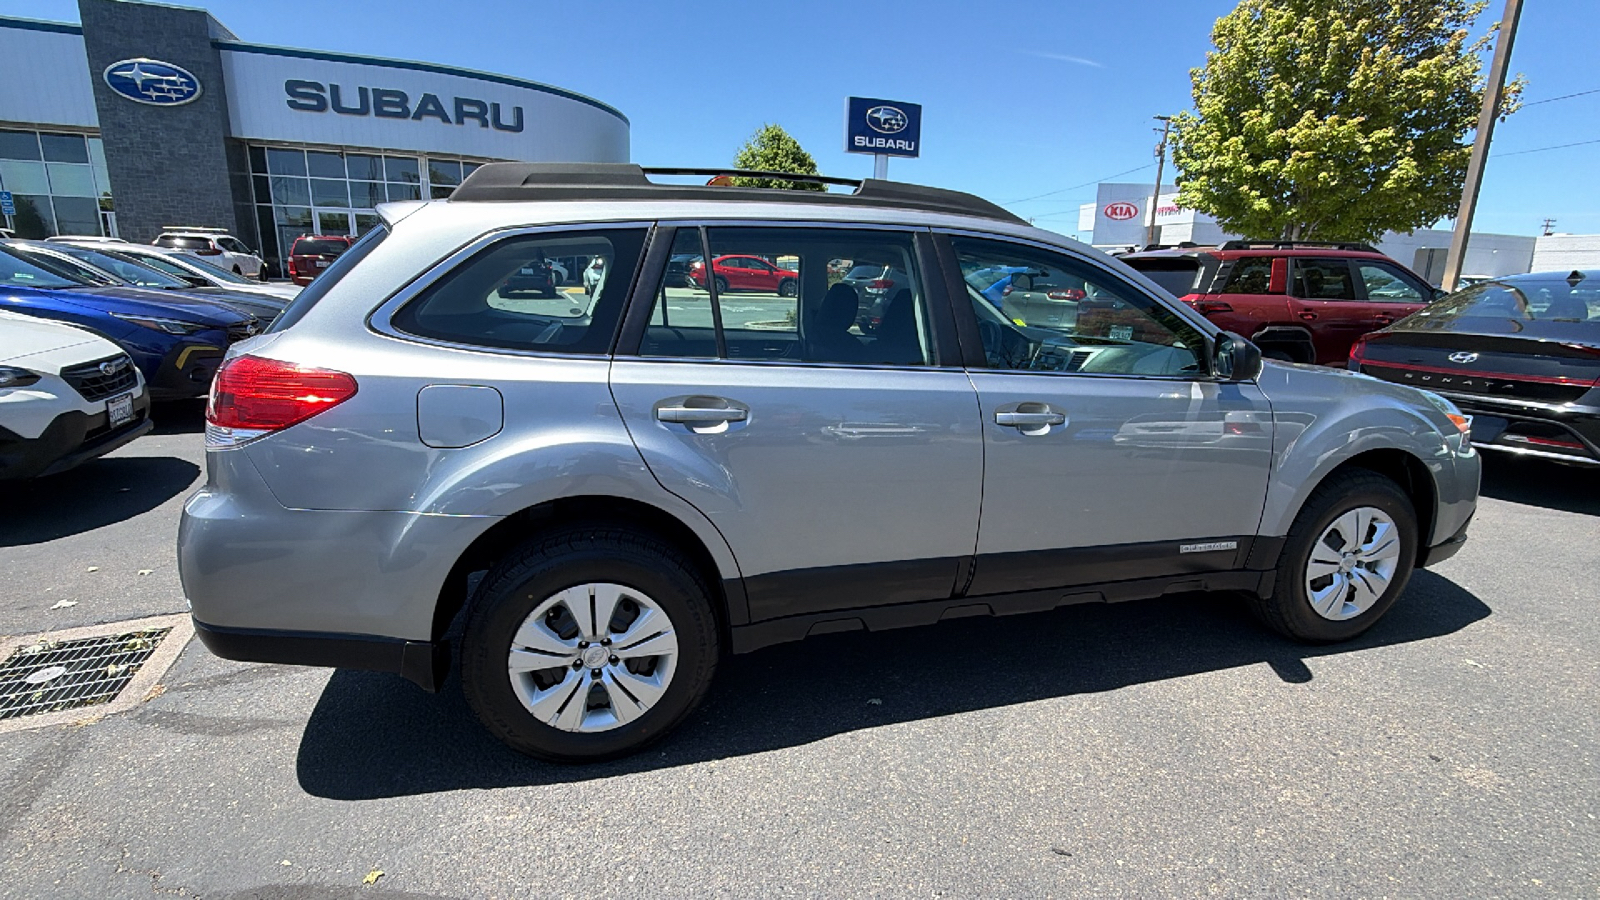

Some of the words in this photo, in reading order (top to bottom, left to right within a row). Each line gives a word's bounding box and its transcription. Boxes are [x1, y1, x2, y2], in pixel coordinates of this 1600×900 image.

[284, 79, 524, 133] SUBARU
[854, 135, 914, 150] SUBARU
[1109, 206, 1133, 217] KIA
[1405, 373, 1514, 388] SONATA
